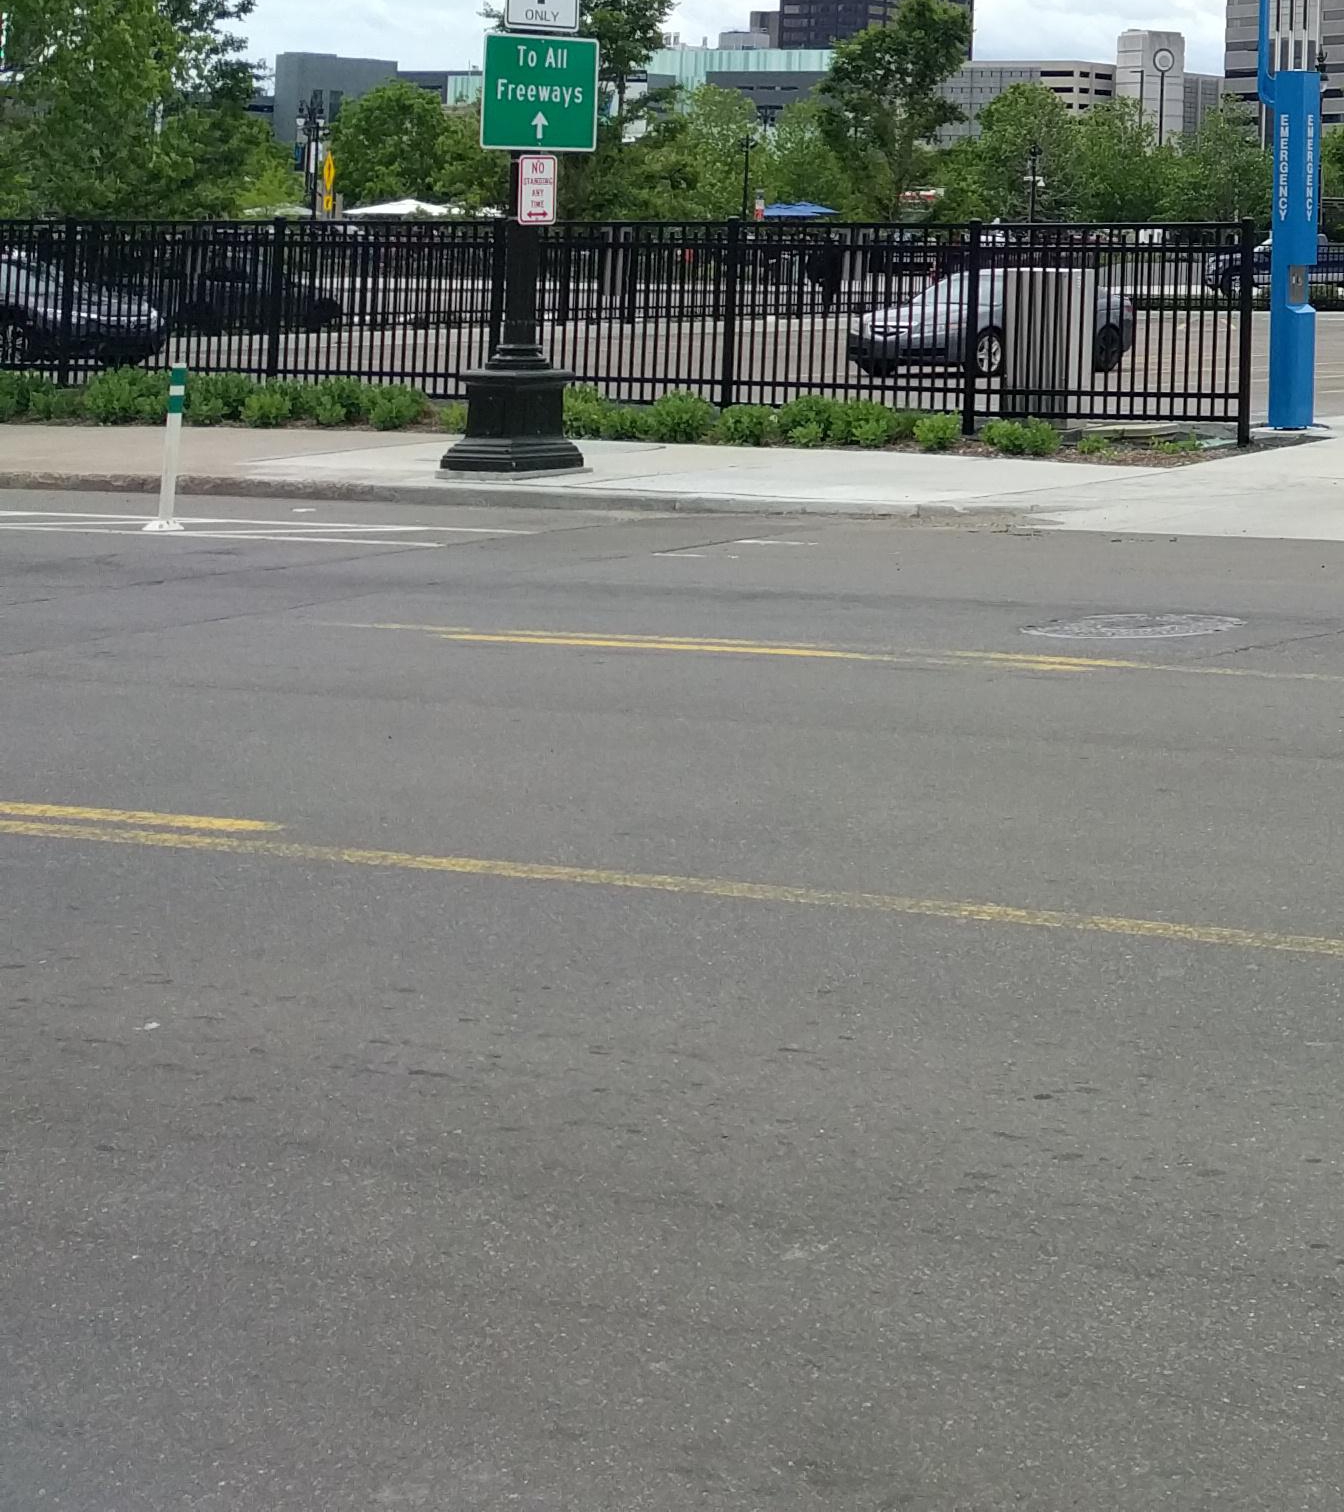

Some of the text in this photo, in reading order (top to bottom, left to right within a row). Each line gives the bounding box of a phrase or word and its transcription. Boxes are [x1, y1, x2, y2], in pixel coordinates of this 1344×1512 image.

[525, 9, 560, 22] ONLY
[517, 45, 567, 68] To All
[497, 78, 583, 108] Freeways
[531, 161, 545, 174] NO
[1279, 114, 1289, 221] EMERGENCY
[1306, 114, 1314, 221] EMERGENCY
[531, 189, 545, 197] ANY
[531, 199, 545, 208] TIME
